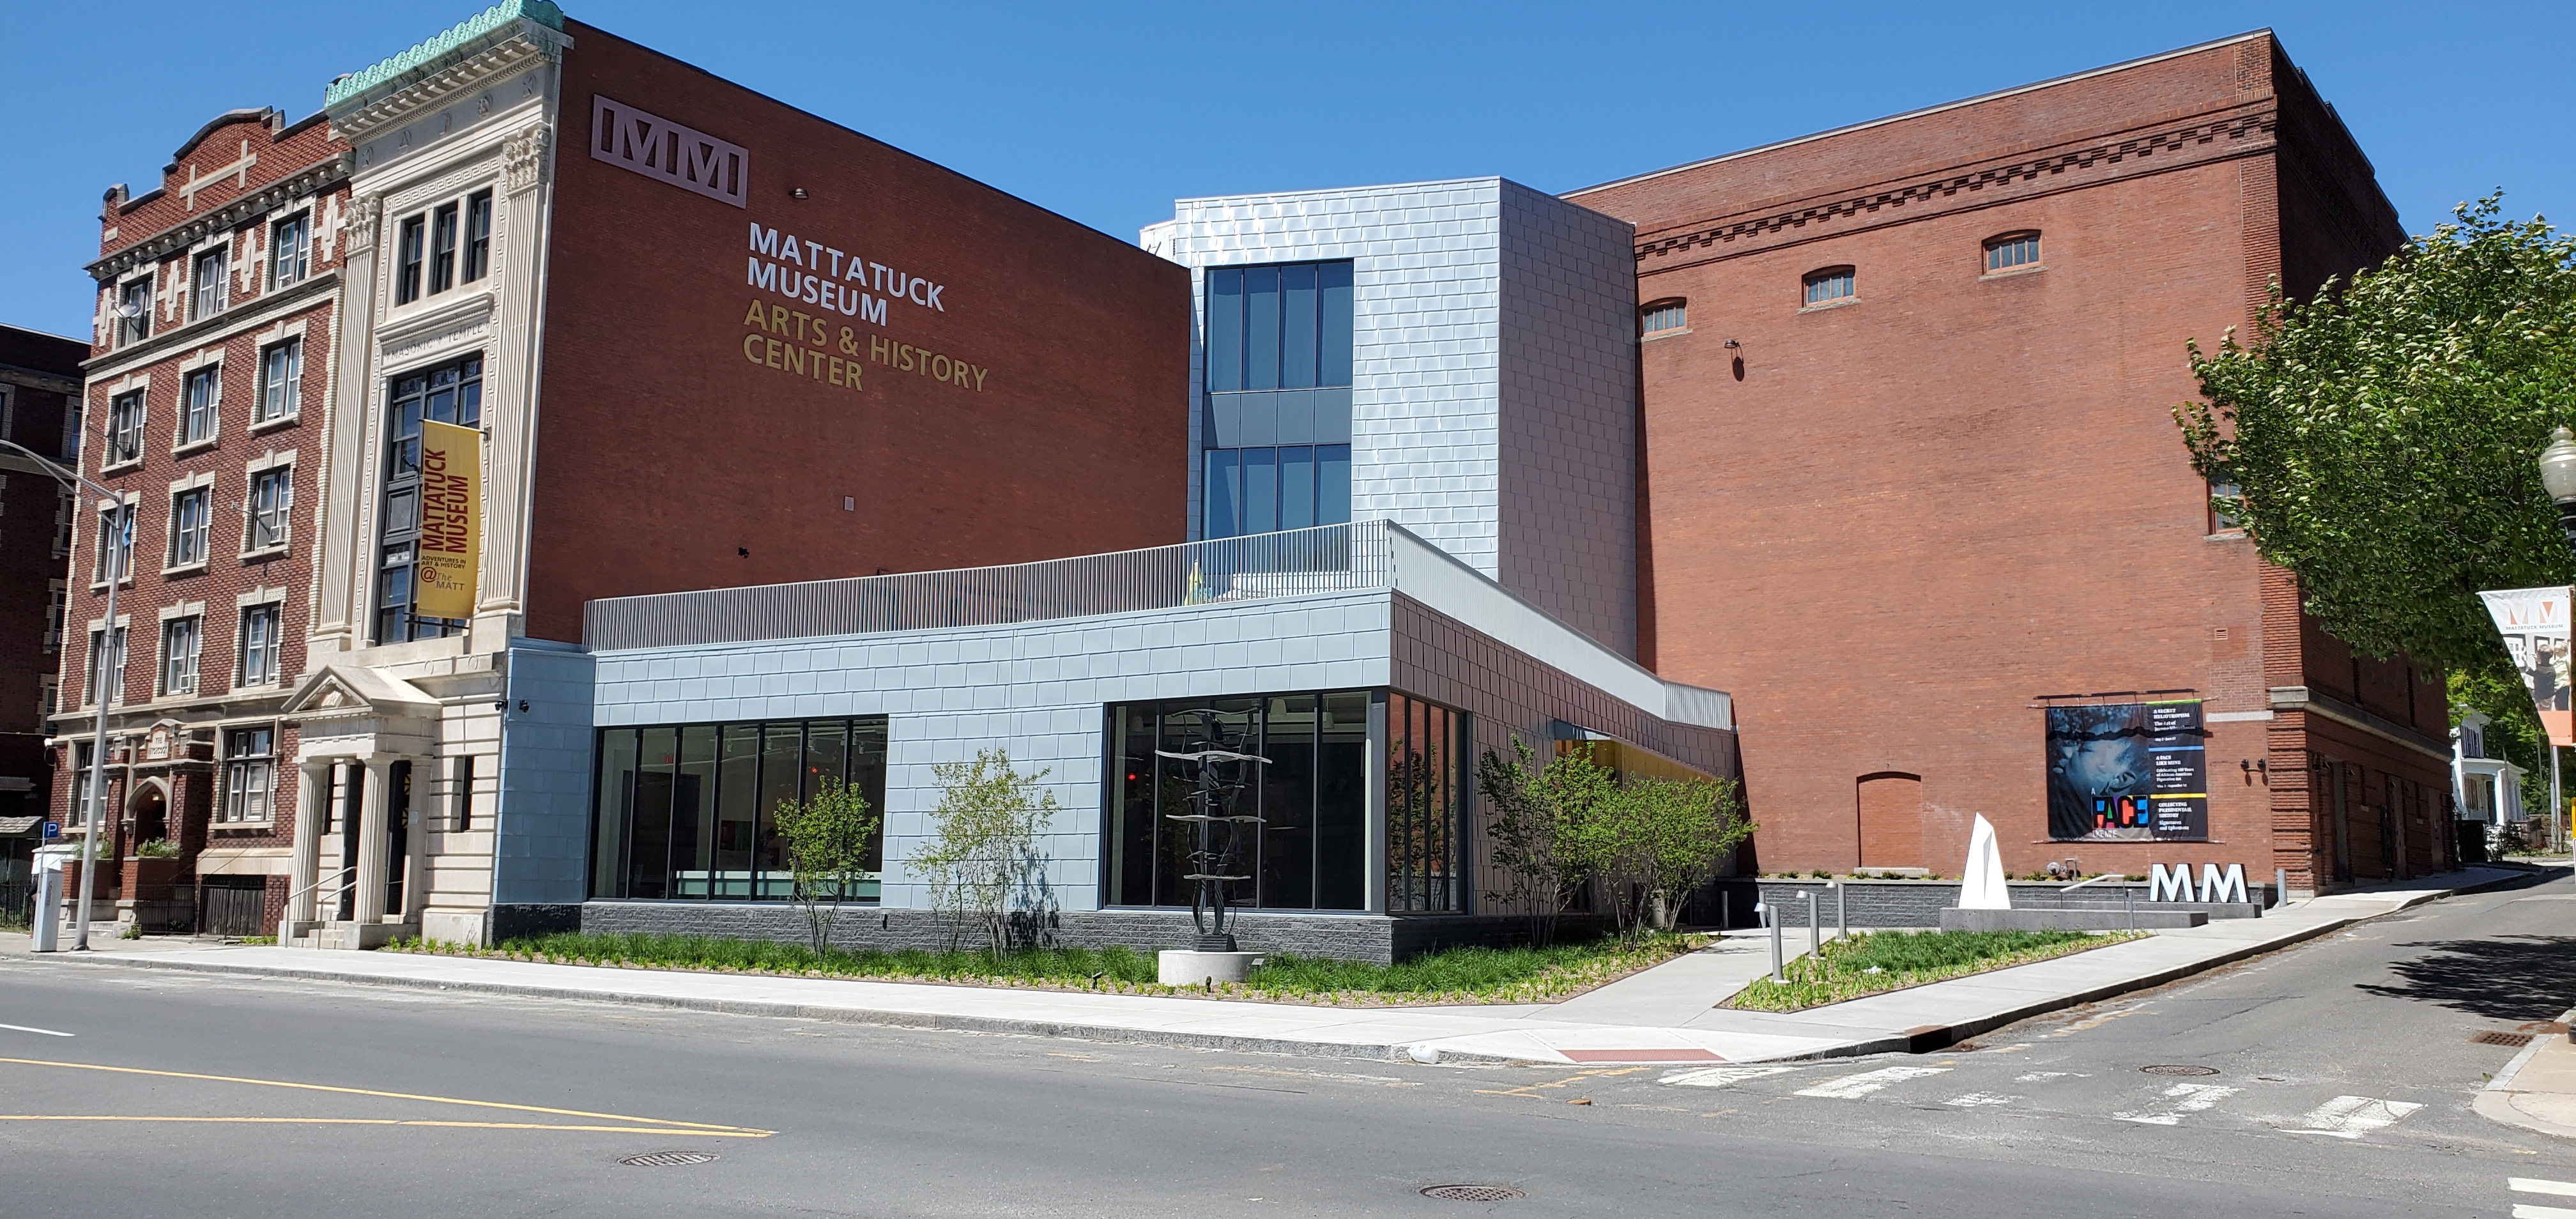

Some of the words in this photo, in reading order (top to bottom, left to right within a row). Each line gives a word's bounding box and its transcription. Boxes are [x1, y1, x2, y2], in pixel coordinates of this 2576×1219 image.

[749, 222, 944, 312] MATTATUCK
[747, 256, 887, 326] MUSEUM
[391, 338, 433, 360] MASONIC
[448, 322, 483, 343] TEMPLE
[744, 298, 827, 347] ARTS
[838, 326, 860, 356] &
[870, 335, 989, 392] HISTORY
[743, 334, 863, 392] CENTER
[422, 447, 445, 551] MATTATUCK
[445, 475, 468, 554] MUSEUM
[422, 555, 459, 564] ADVENTURES
[437, 572, 452, 581] The
[436, 581, 465, 591] MATT
[48, 824, 57, 837] P
[2092, 795, 2148, 829] FACE
[2149, 862, 2250, 903] MM
